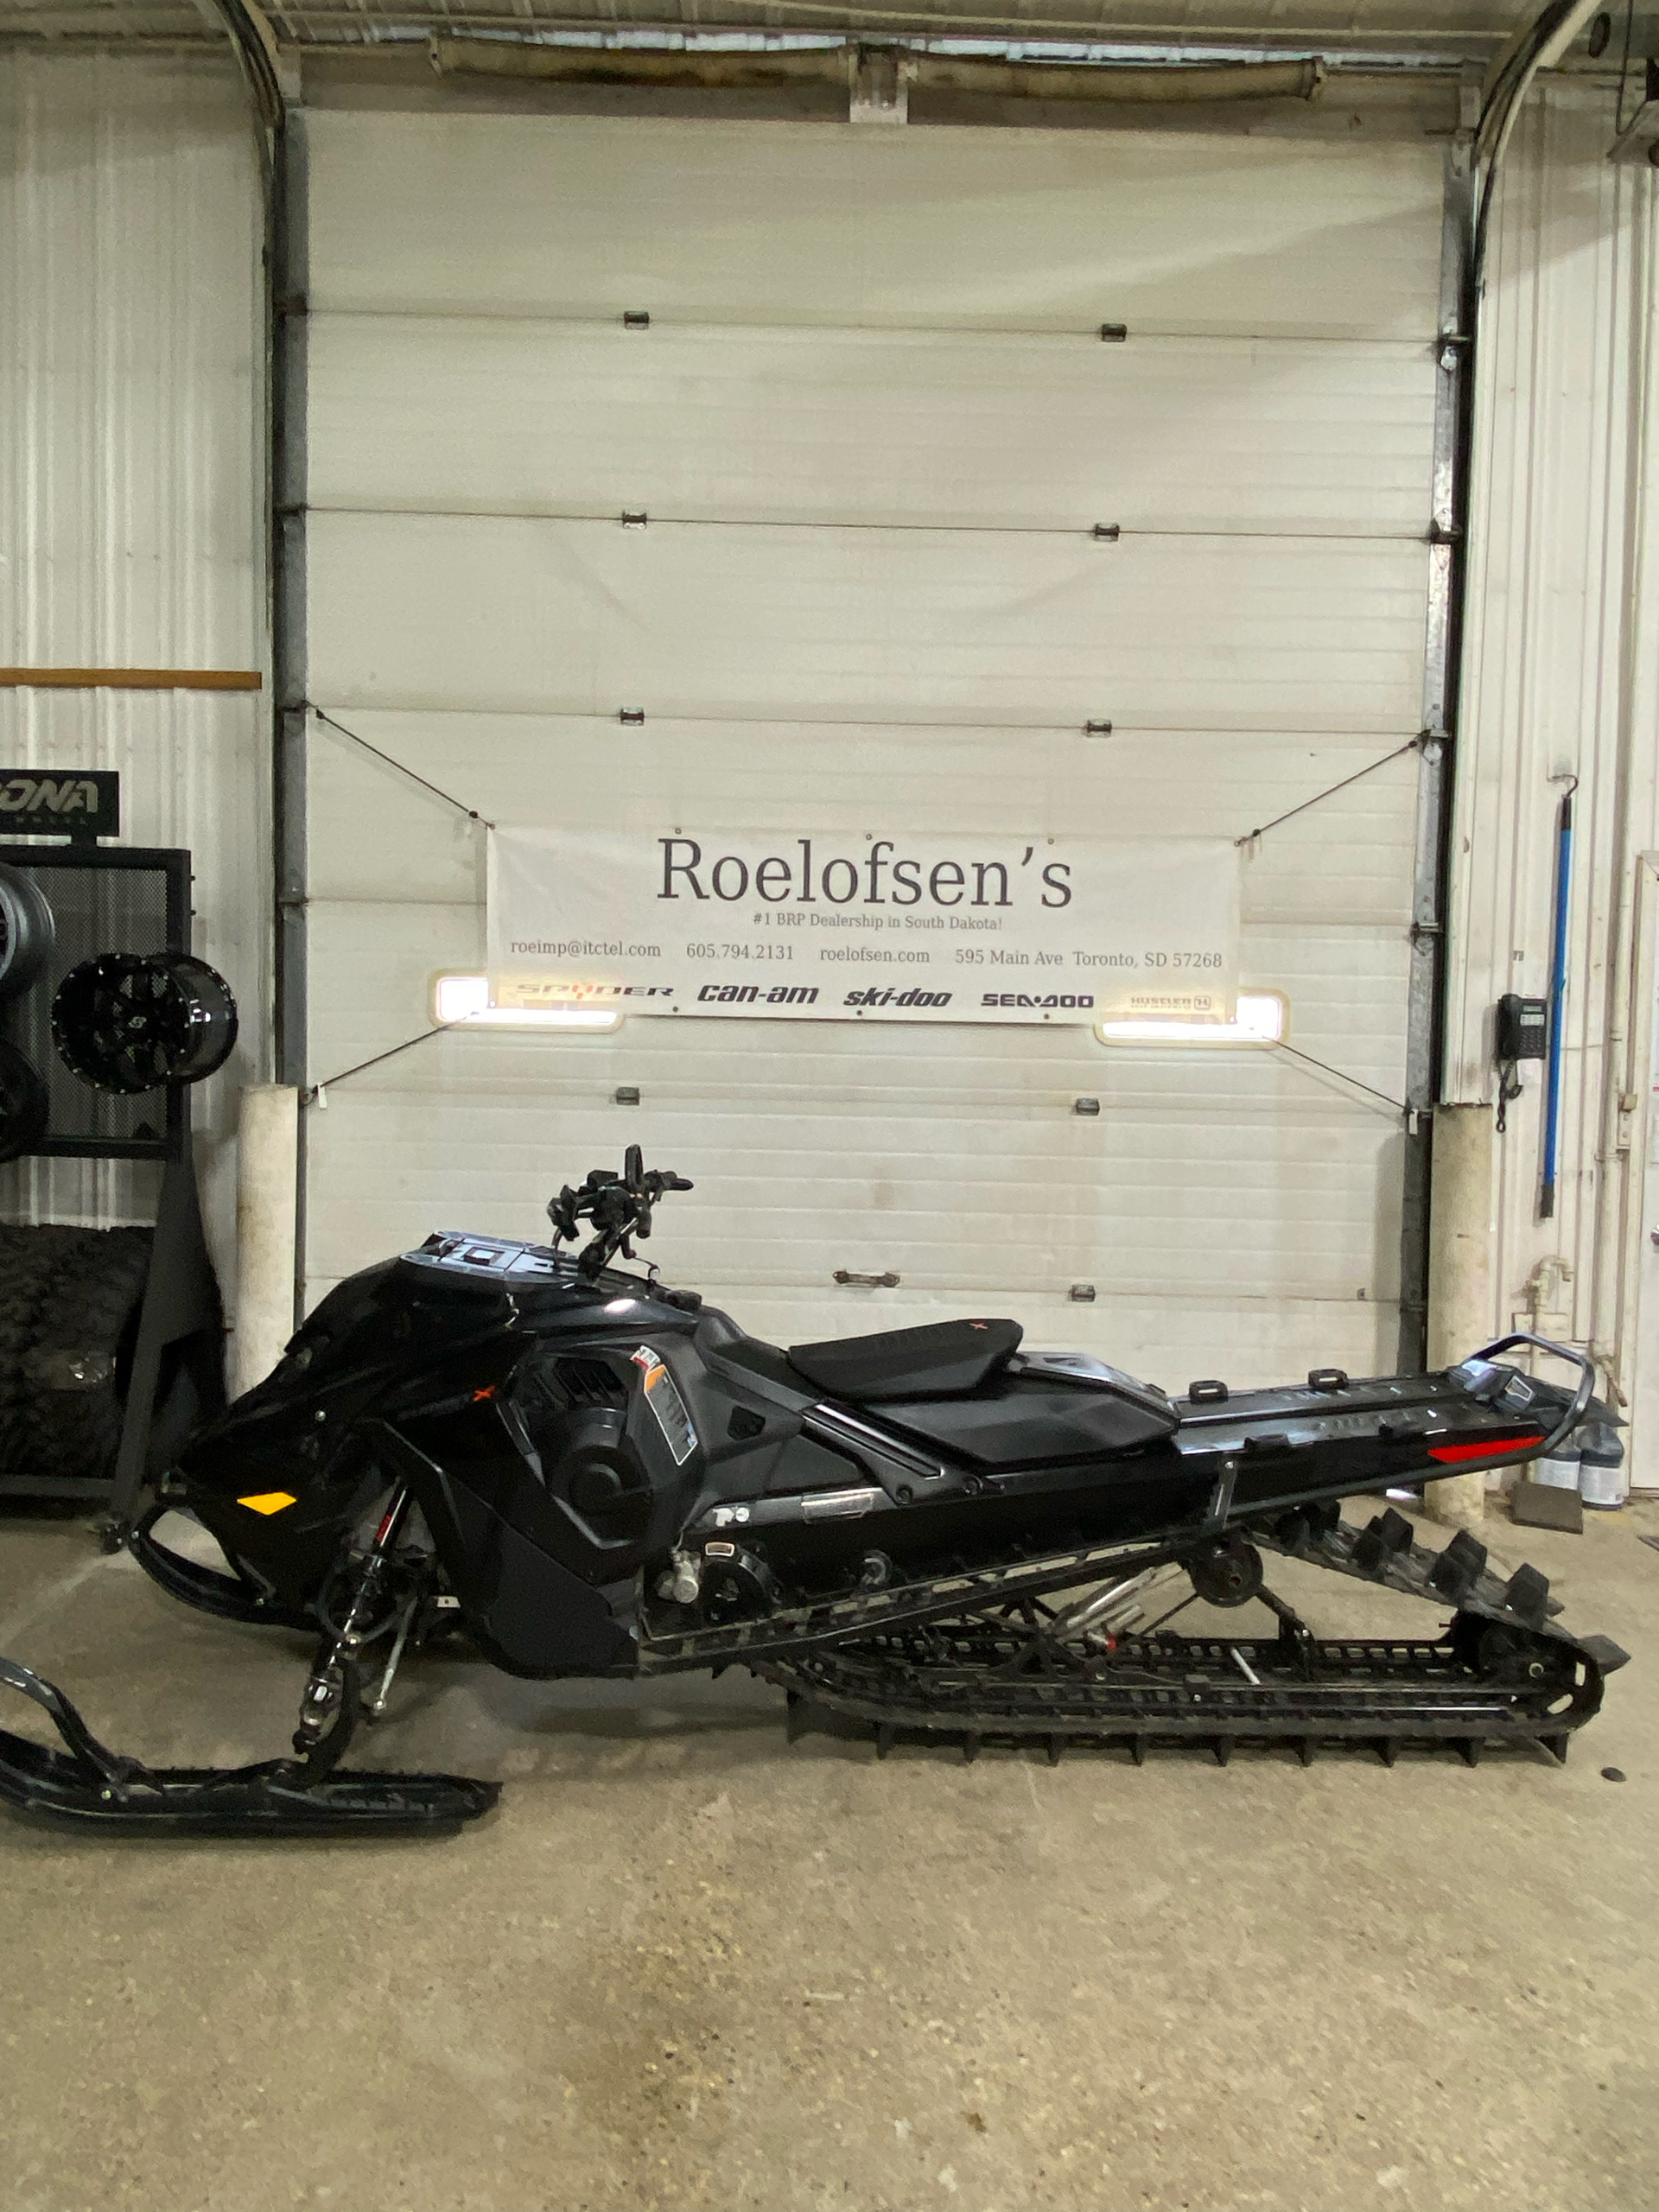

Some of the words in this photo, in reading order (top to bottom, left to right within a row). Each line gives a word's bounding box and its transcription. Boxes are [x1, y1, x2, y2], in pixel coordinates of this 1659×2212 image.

[0, 779, 99, 812] ONA
[657, 838, 1072, 908] Roelofsen's
[753, 912, 771, 925] #1
[778, 913, 805, 926] BRP
[810, 913, 882, 931] Dealership
[888, 915, 900, 927] in
[905, 916, 944, 929] South
[950, 917, 1002, 931] Dakota!
[511, 940, 662, 957] roeimp@itctel.com
[687, 944, 793, 961] 605.794.2131
[821, 946, 931, 963] roelofsen.com
[955, 949, 984, 964] 595
[989, 950, 1029, 965] Main
[1035, 950, 1063, 965] Ave
[1072, 951, 1138, 969] Toronto,
[1145, 952, 1167, 967] SD
[1173, 953, 1223, 968] 57268
[517, 984, 674, 1000] SPYDER
[843, 987, 952, 1007] ski-doo
